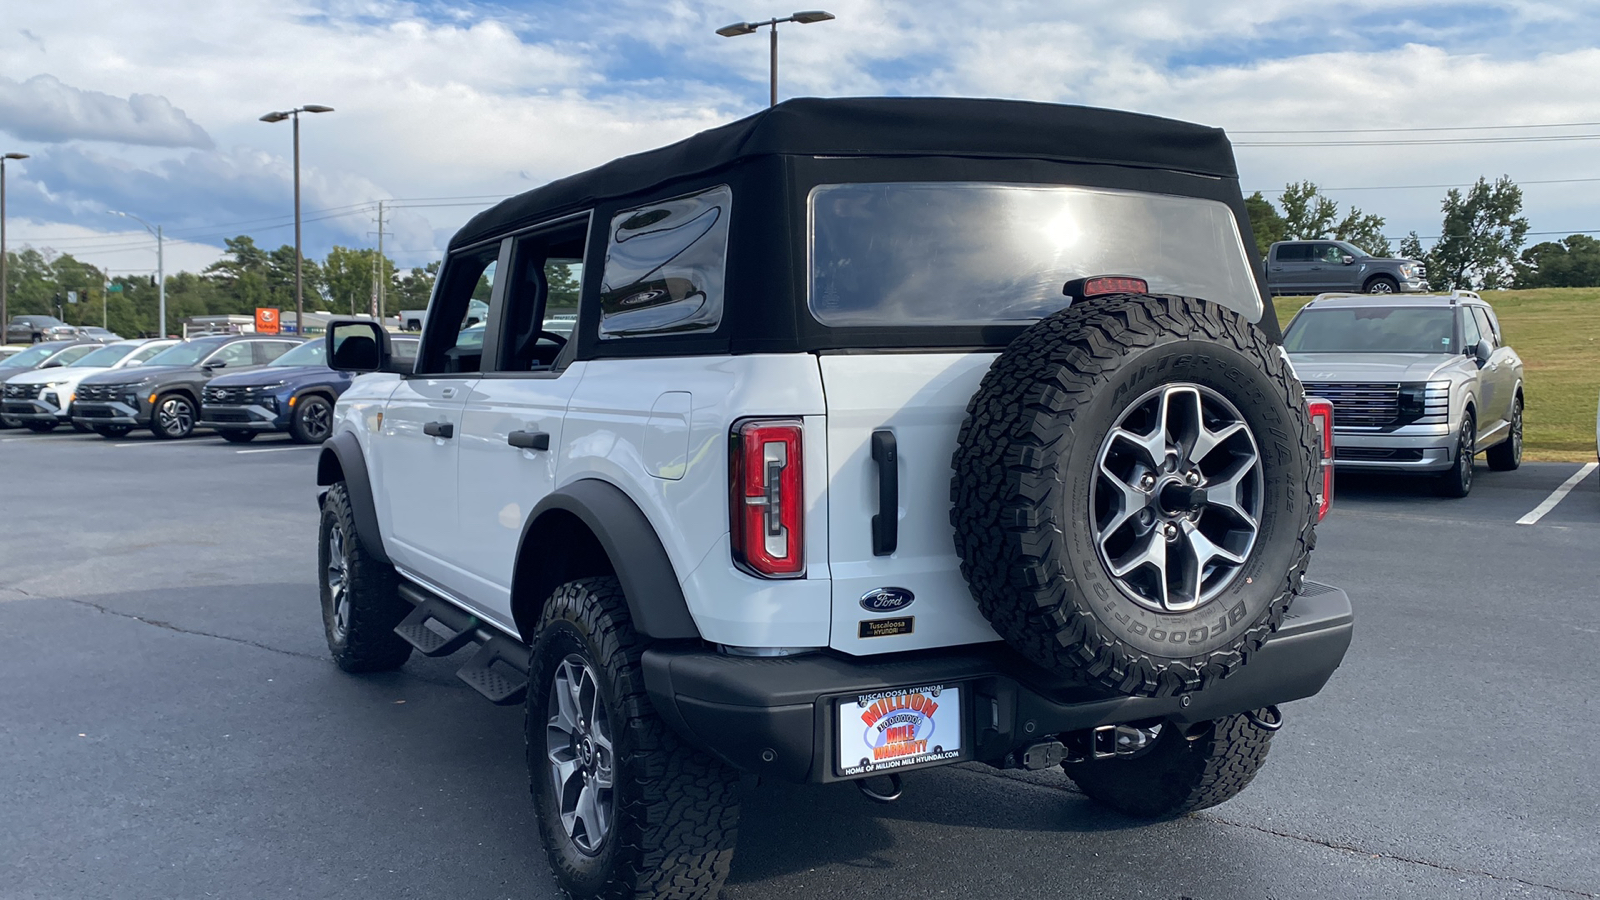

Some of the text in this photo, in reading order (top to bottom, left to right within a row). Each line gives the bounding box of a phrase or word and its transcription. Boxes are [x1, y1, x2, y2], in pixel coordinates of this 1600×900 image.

[873, 592, 903, 608] Ford
[1082, 559, 1247, 646] BFGoodrich
[868, 621, 906, 630] Tuscaloosa
[873, 627, 899, 635] HYUNDAI
[858, 684, 944, 702] TUSCALOOSA HYUNDAI
[860, 692, 939, 728] MILLION
[886, 724, 915, 744] MILE
[872, 739, 928, 760] WARRANTY
[845, 750, 960, 776] HOME OF MILLION MILE HYUNDAI.COM
